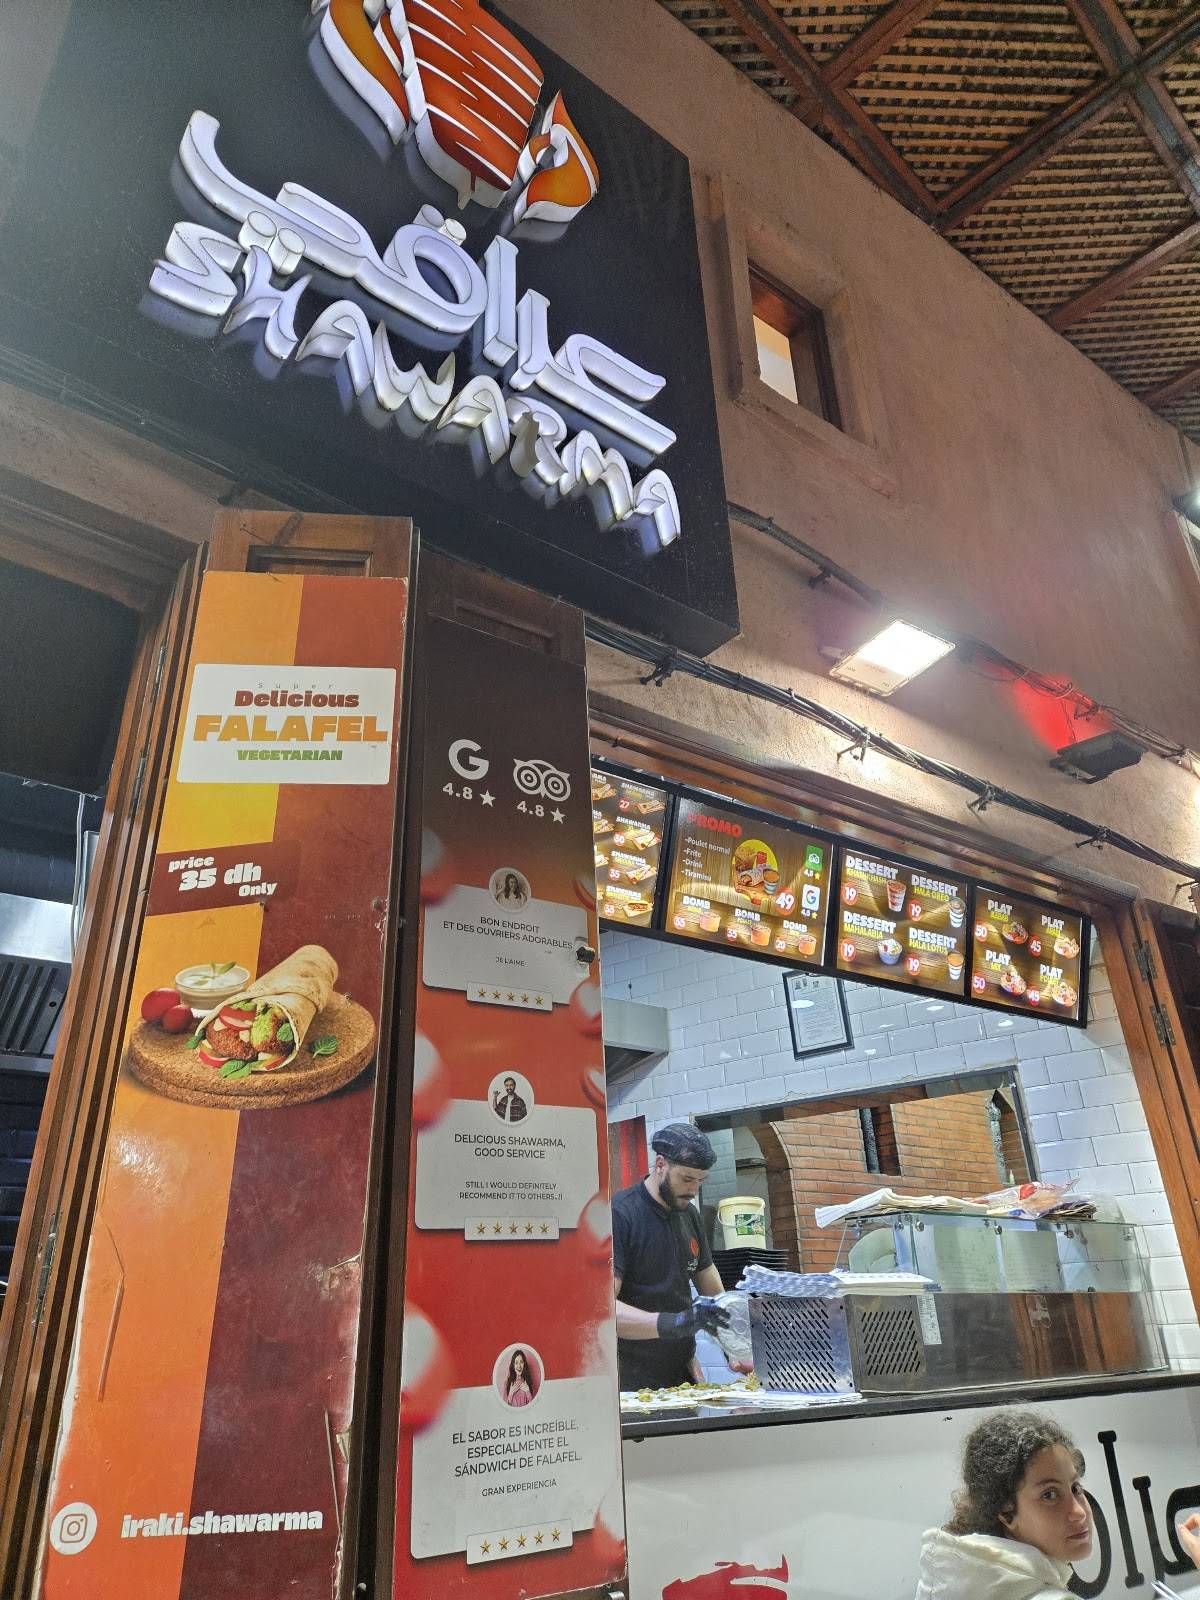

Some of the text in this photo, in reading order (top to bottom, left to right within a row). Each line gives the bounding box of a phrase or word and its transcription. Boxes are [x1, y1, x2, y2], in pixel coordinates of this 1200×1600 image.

[178, 110, 677, 456] عراقي
[149, 220, 682, 548] SHAWARMA
[258, 682, 336, 690] Super
[234, 690, 360, 708] Delicious
[193, 715, 388, 741] FALAFEL
[237, 749, 343, 761] VEGETARIAN
[442, 782, 473, 800] 4.8
[517, 800, 545, 817] 4.8
[619, 799, 630, 809] 27
[687, 812, 743, 838] PROMO
[708, 843, 731, 855] normal
[168, 856, 214, 873] price
[845, 855, 899, 879] DESSERT
[179, 862, 262, 891] 35 dh
[239, 882, 277, 897] Only
[845, 886, 857, 900] 19
[911, 874, 959, 896] DESSERT
[776, 892, 795, 910] 49
[914, 886, 949, 902] HALA OREO
[682, 895, 711, 910] BOMB
[910, 903, 922, 917] 19
[987, 899, 1013, 915] PLAT
[735, 908, 761, 922] BOMB
[843, 910, 897, 934] DESSERT
[1041, 915, 1065, 931] PLAT
[480, 916, 540, 934] BON ENDROIT
[783, 920, 807, 932] BOMB
[975, 924, 988, 938] 50
[443, 921, 573, 949] ET DES OUVRIERS ADORABLES
[909, 927, 957, 949] DESSERT
[843, 942, 855, 957] 19
[909, 938, 949, 955] HALA LOTUS
[1030, 939, 1042, 953] 45
[908, 957, 920, 972] 19
[985, 949, 1011, 966] PLAT
[1039, 963, 1063, 979] PLAT
[973, 975, 986, 989] 50
[1029, 989, 1040, 1001] 45
[454, 1133, 566, 1148] DELICIOUS SHAWARMA,
[474, 1147, 546, 1159] GOOD SERVICE
[465, 1181, 484, 1189] STILL
[518, 1182, 557, 1190] DEFINITELY
[459, 1192, 507, 1200] RECOMMEND
[508, 1192, 514, 1200] IT
[452, 1419, 579, 1444] EL SABOR ES INCREÍBLE,
[467, 1437, 568, 1459] ESPECIALMENTE EL
[454, 1458, 516, 1477] SÁNDWICH
[519, 1457, 532, 1468] DE
[481, 1478, 557, 1497] GRAN EXPERIENCIA
[120, 1510, 323, 1538] iraki.shawarma
